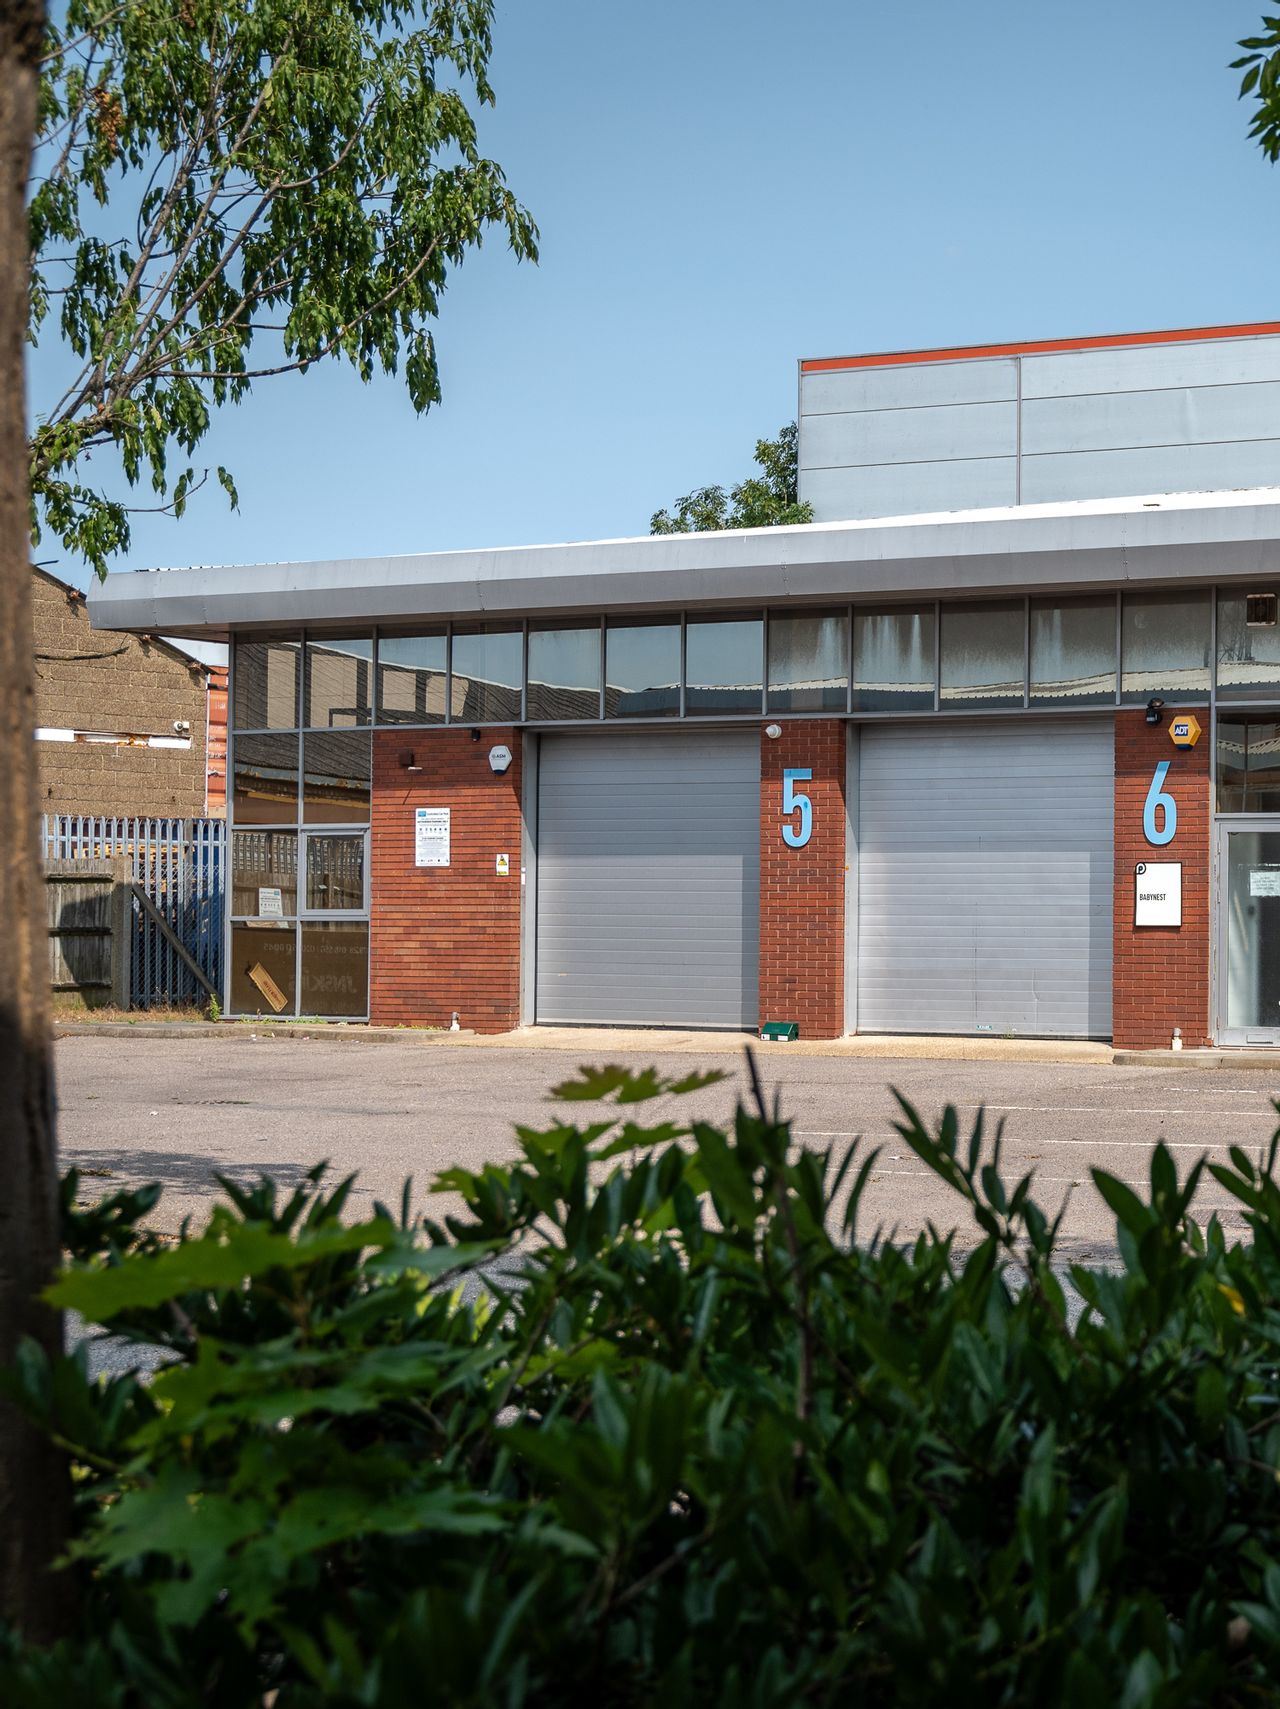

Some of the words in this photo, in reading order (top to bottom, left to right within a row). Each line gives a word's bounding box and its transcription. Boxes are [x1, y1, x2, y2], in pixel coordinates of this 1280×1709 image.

[1174, 726, 1189, 735] ADT
[782, 768, 813, 848] 5
[1143, 760, 1177, 846] 6
[1139, 893, 1167, 901] BABYNEST
